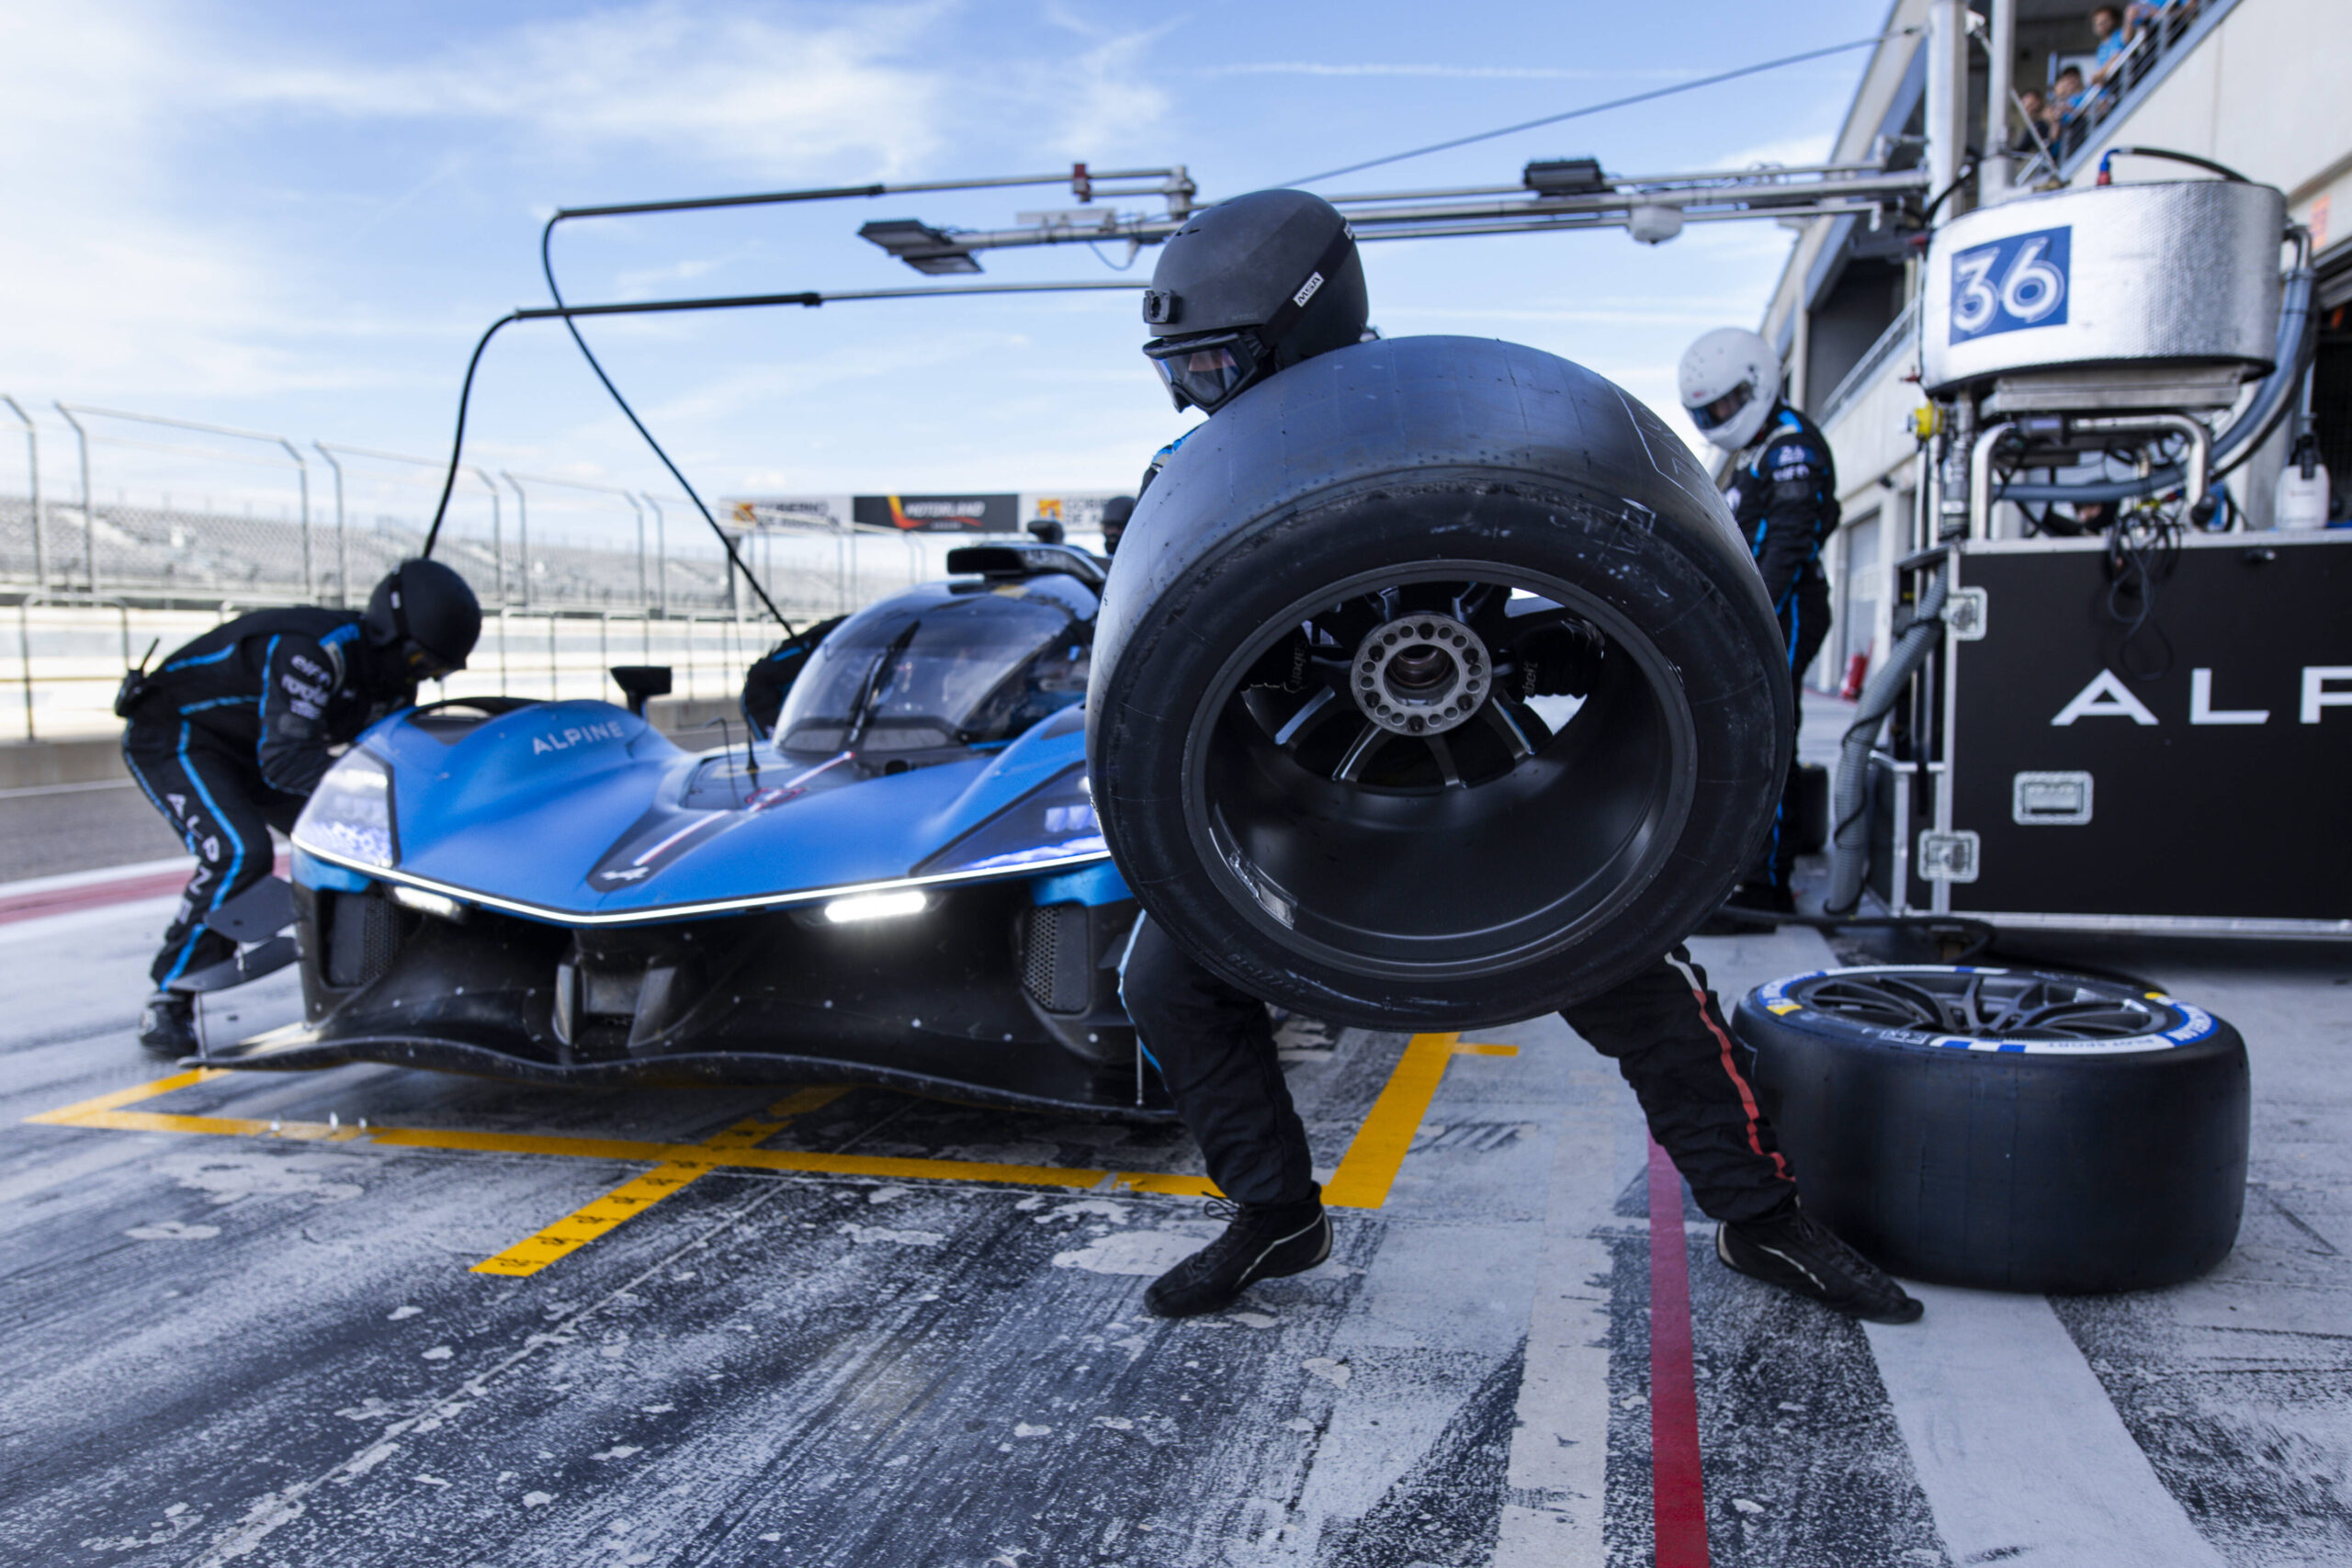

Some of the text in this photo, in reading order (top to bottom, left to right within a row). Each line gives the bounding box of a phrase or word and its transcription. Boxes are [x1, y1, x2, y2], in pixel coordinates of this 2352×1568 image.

[1296, 275, 1323, 305] MSA
[1952, 236, 2066, 335] 36
[532, 720, 625, 755] ALPINE
